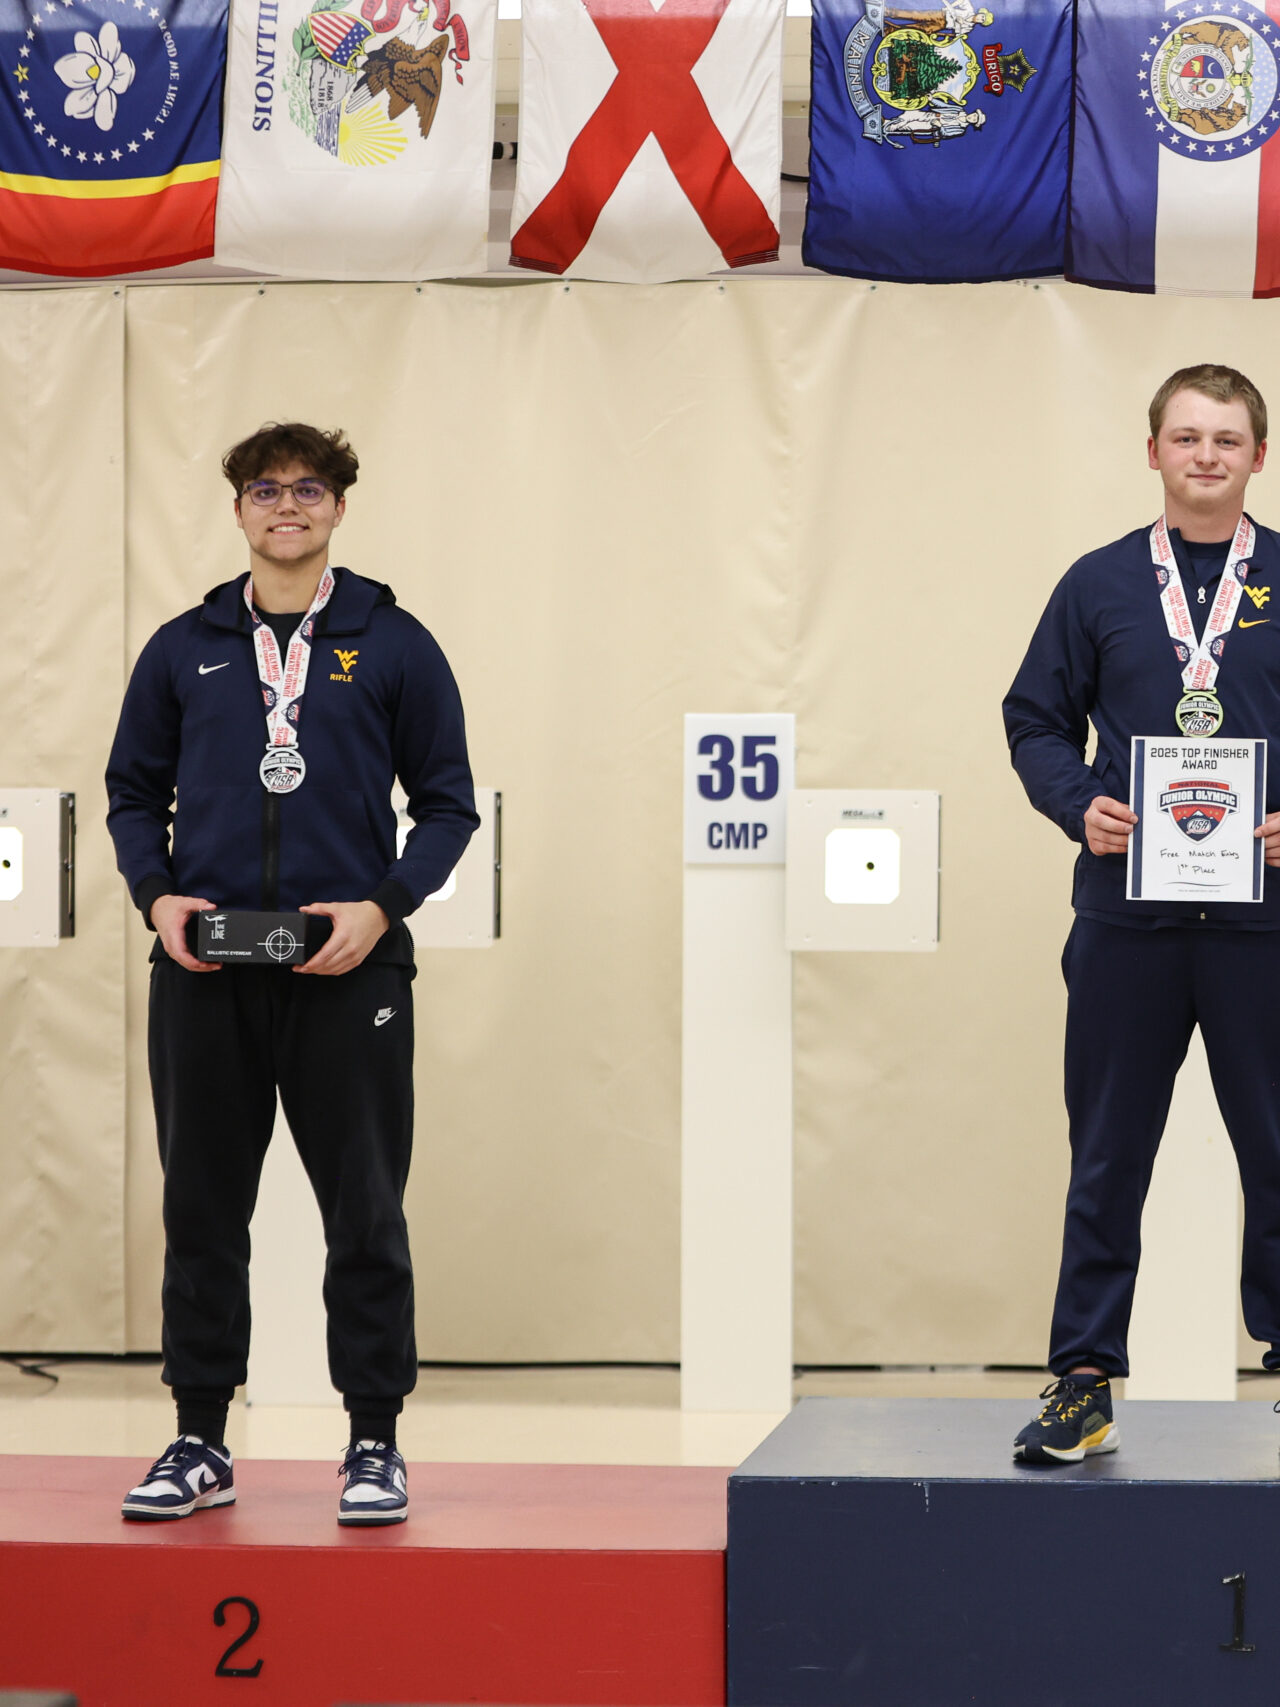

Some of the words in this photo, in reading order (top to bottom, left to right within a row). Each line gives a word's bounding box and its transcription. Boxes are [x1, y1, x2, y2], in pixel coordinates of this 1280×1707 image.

[252, 0, 279, 131] ILLINOIS
[847, 30, 871, 104] MAINE
[985, 49, 1002, 92] DIRIGO
[1209, 607, 1222, 631] JUNIOR
[1216, 578, 1232, 608] OLYMPIC
[264, 631, 275, 651] JUNIOR
[269, 652, 281, 682] OLYMPIC
[287, 643, 298, 671] OLYMPIC
[330, 673, 353, 682] RIFLE
[1192, 658, 1207, 689] OLYMPIC
[1180, 701, 1197, 710] JUNIOR
[1198, 700, 1219, 711] OLYMPIC
[1188, 720, 1211, 731] USA
[1150, 747, 1178, 758] 2025
[1181, 747, 1201, 759] TOP
[1204, 748, 1249, 759] FINISHER
[1182, 759, 1218, 770] AWARD
[697, 734, 779, 801] 35
[272, 774, 293, 786] USA
[1161, 790, 1194, 805] JUNIOR
[1195, 790, 1236, 805] OLYMPIC
[707, 822, 768, 849] CMP
[1190, 820, 1209, 830] USA
[1160, 848, 1180, 858] Free
[1189, 850, 1215, 858] Match
[1221, 849, 1240, 859] Entry
[1192, 865, 1216, 874] Place
[1217, 1571, 1256, 1653] 1
[212, 1596, 265, 1679] 2
